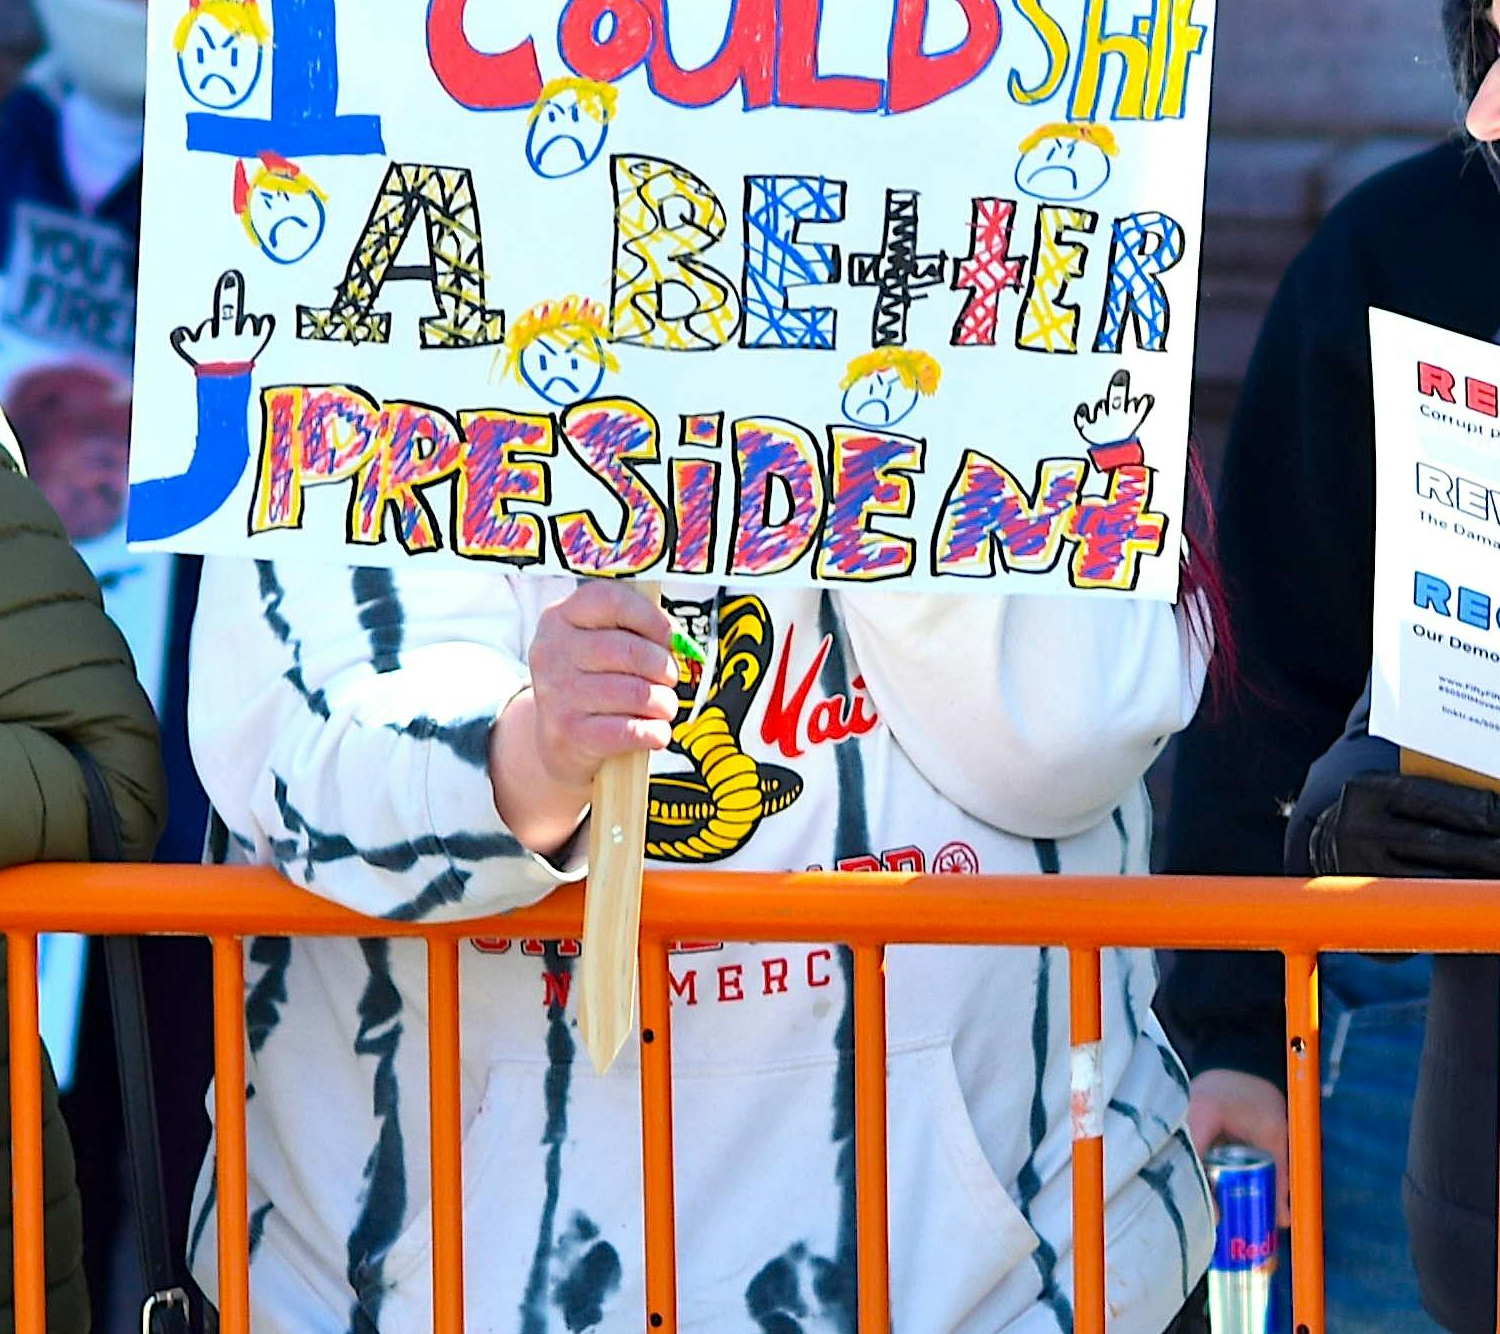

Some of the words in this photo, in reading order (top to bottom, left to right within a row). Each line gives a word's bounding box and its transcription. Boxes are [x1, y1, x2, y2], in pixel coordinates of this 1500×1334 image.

[297, 161, 505, 349] A
[1420, 403, 1485, 437] Corrupt
[1419, 509, 1448, 530] The
[1413, 623, 1445, 644] Our
